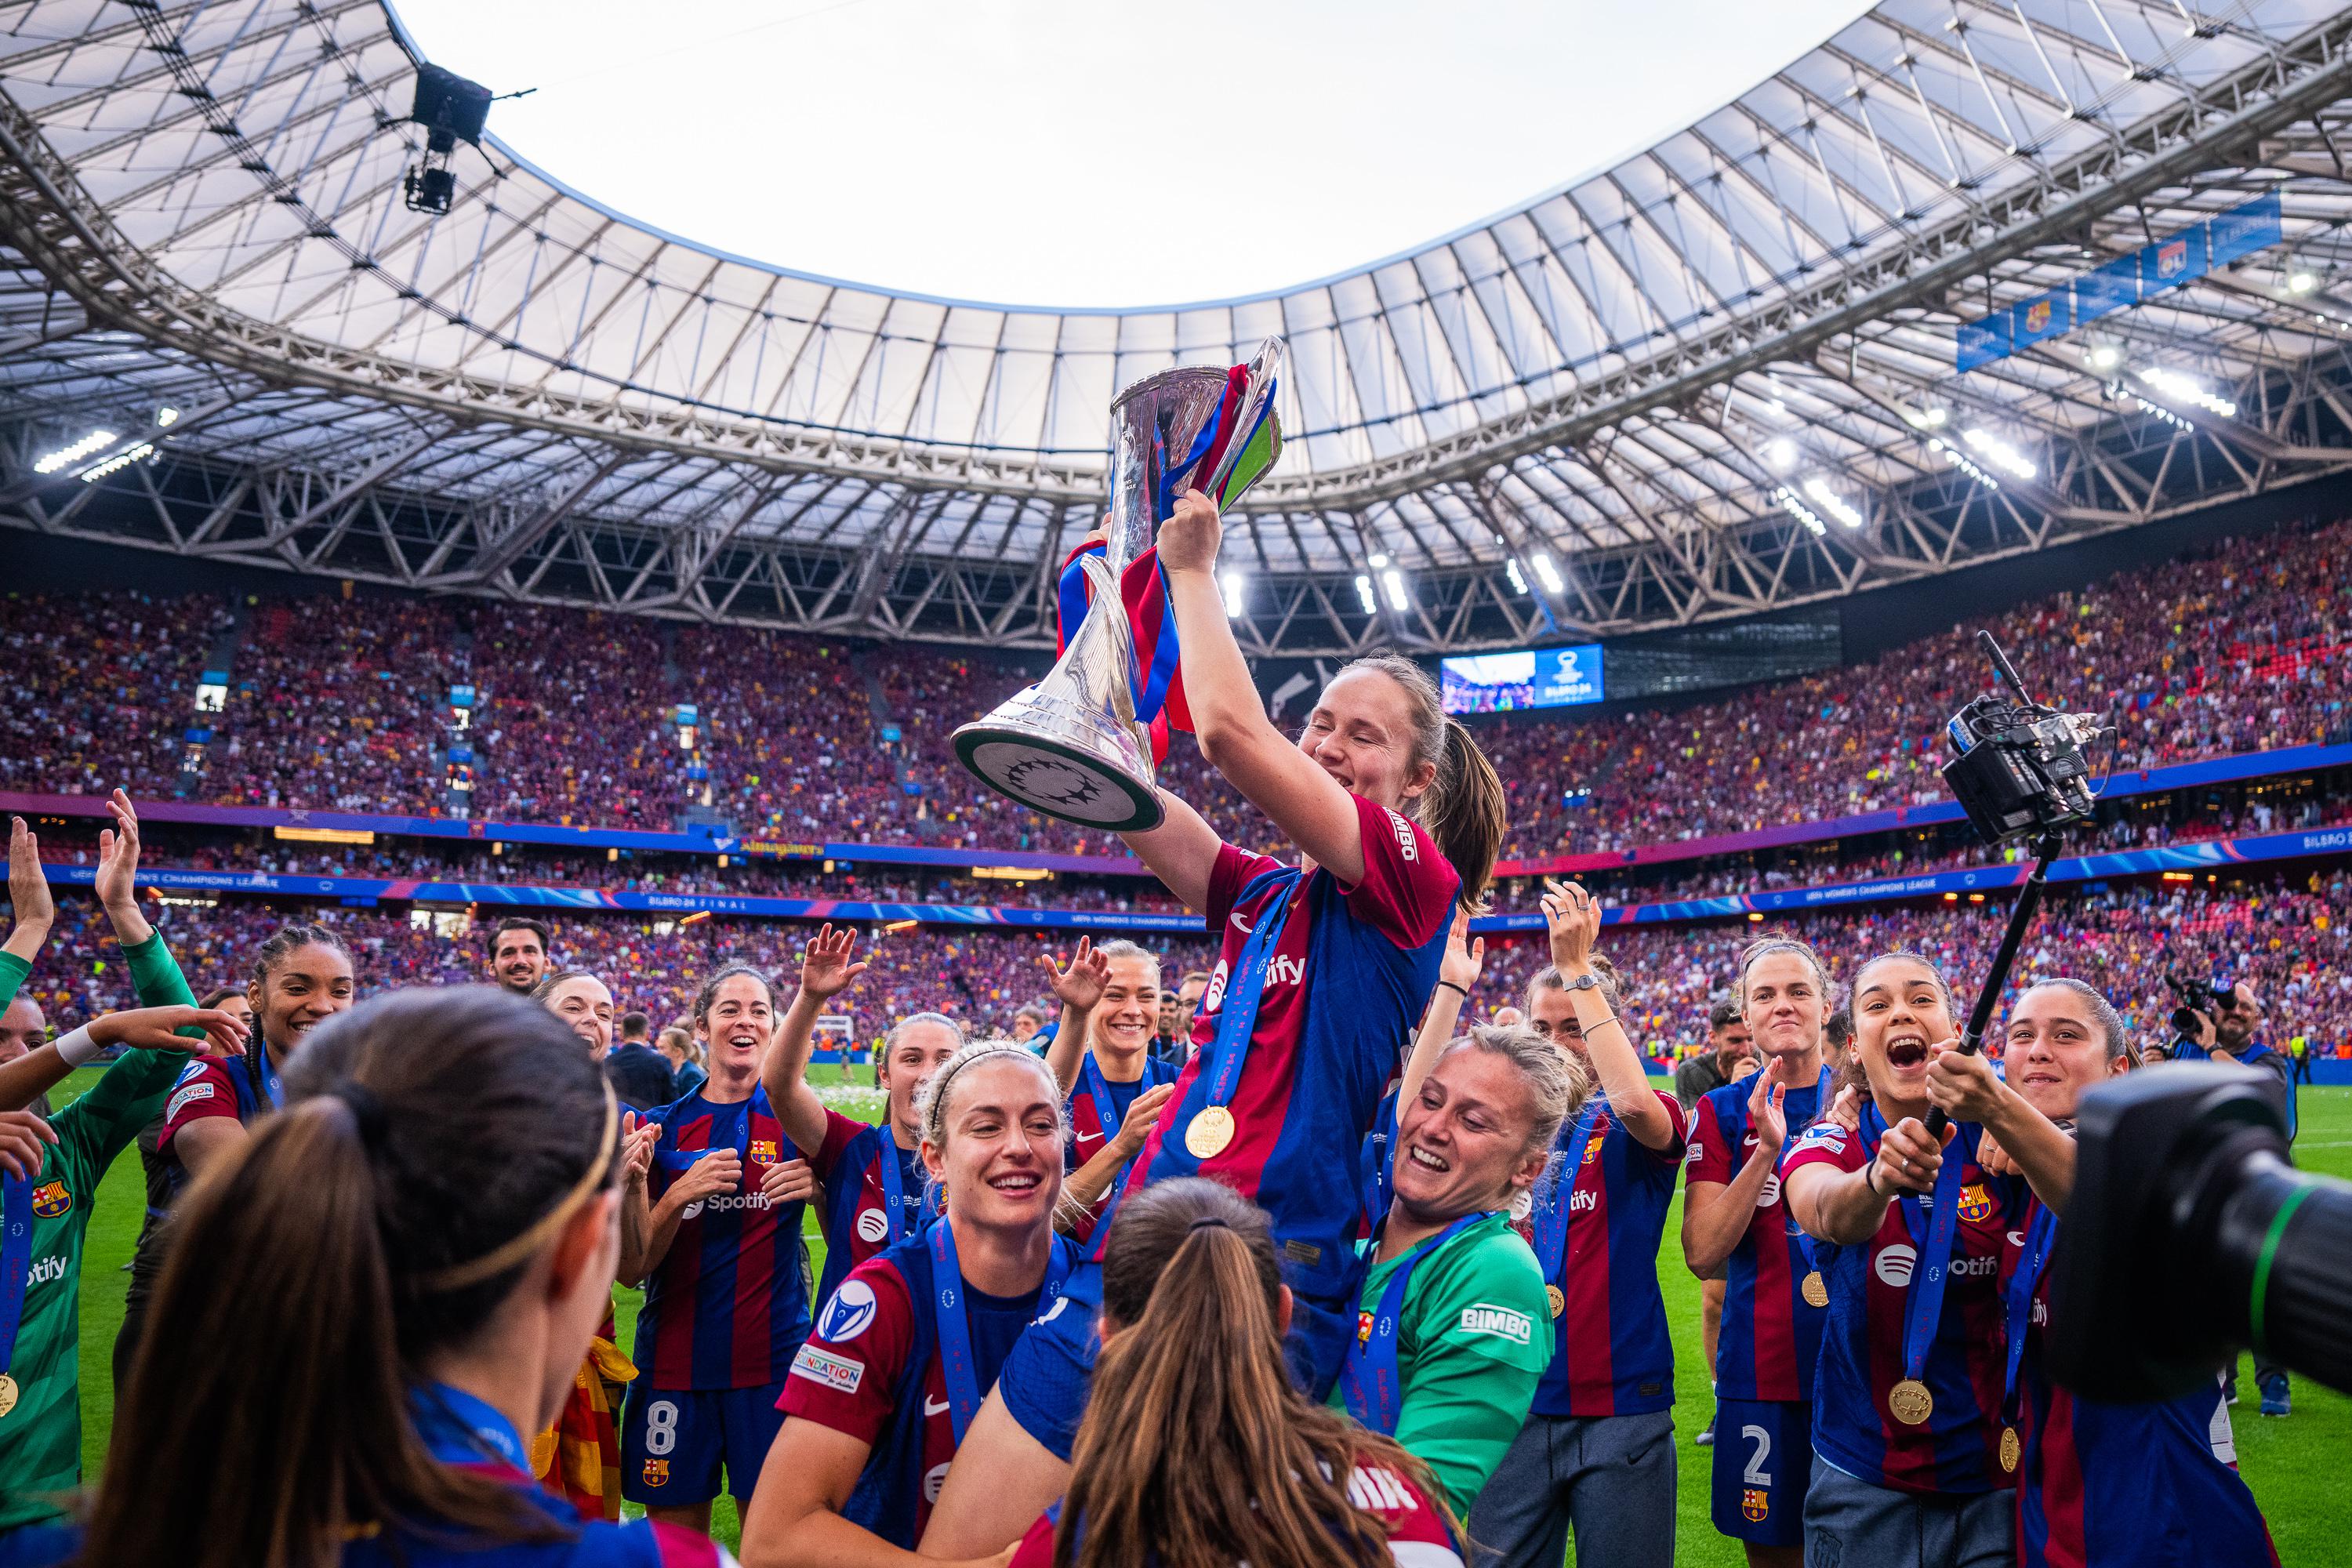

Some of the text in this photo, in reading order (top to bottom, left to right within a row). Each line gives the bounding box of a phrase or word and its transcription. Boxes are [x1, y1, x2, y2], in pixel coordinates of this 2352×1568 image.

[708, 1192, 772, 1212] Spotify
[1461, 1308, 1531, 1341] BIMBO
[646, 1401, 679, 1455] 8
[1742, 1425, 1771, 1486] 2
